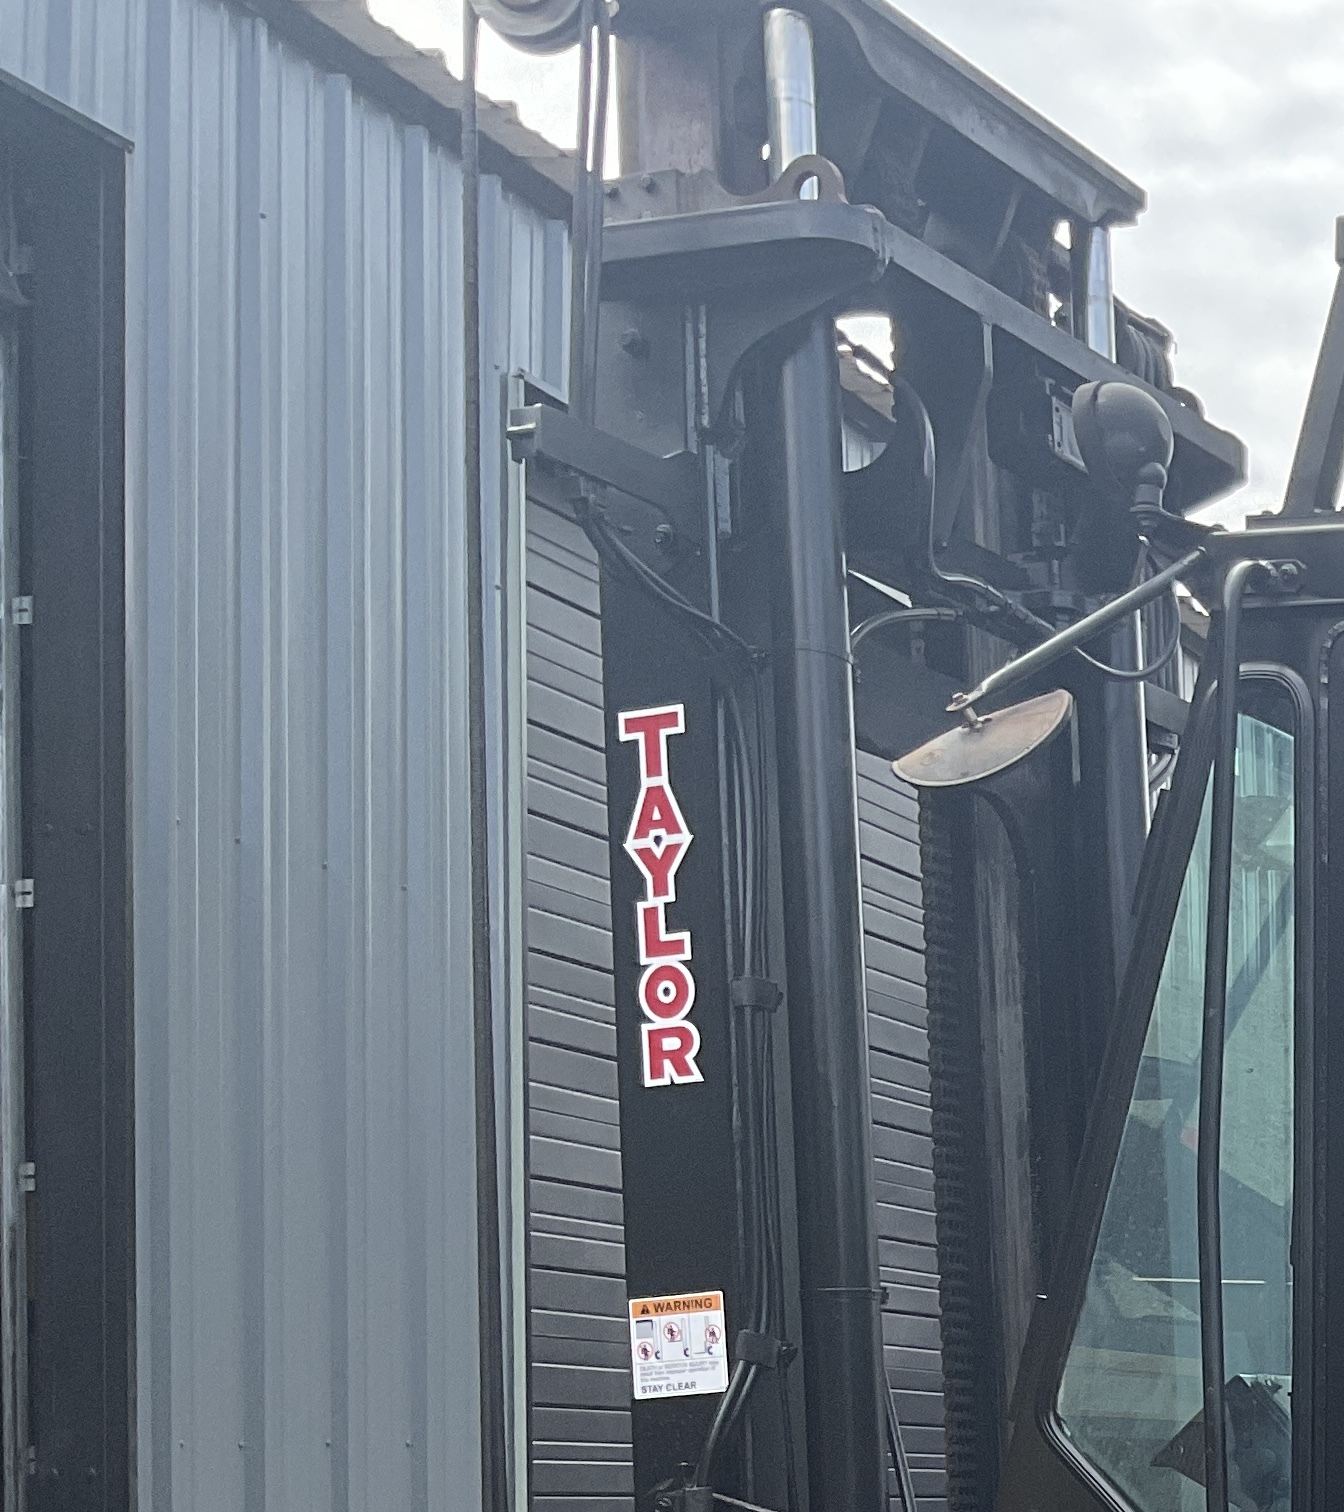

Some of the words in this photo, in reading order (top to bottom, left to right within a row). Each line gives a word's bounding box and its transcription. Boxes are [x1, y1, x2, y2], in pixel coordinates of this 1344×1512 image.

[618, 704, 704, 1088] TAYLOR
[653, 1298, 713, 1314] WARNING
[641, 1384, 663, 1394] STAY
[666, 1381, 697, 1392] CLEAR
